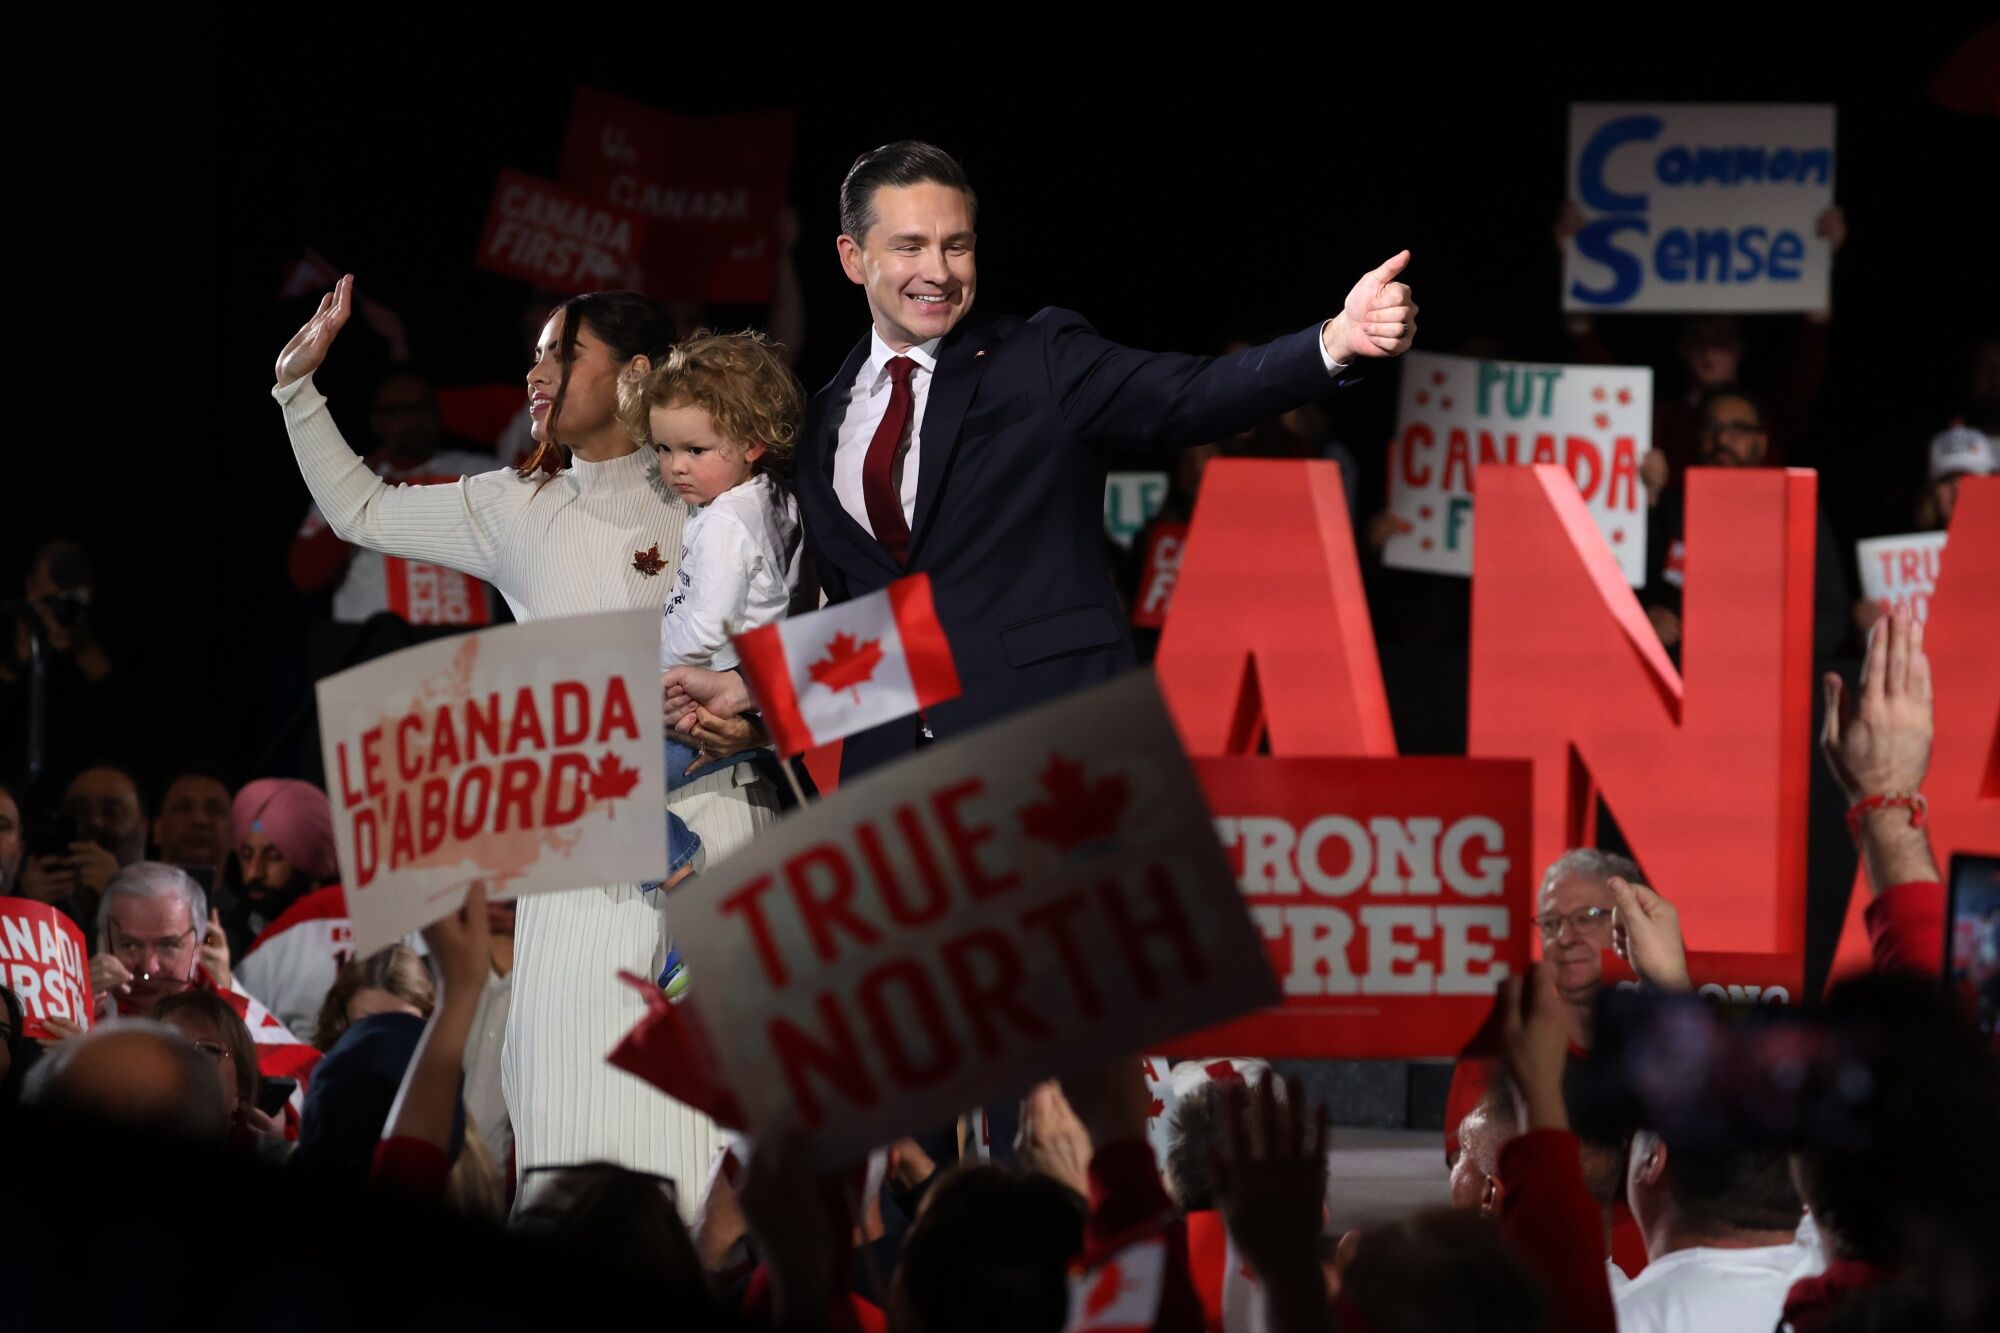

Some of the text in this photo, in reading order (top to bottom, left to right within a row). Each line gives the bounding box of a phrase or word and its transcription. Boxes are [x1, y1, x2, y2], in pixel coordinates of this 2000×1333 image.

[1578, 113, 1830, 213] Common
[488, 221, 606, 285] FIRST
[501, 185, 632, 256] CANADA
[1571, 217, 1804, 306] Sense
[1476, 361, 1561, 418] PUT
[338, 676, 640, 808] LE CANADA
[352, 753, 592, 889] D'ABORD
[720, 777, 1019, 989] TRUE
[768, 864, 1188, 1129] NORTH
